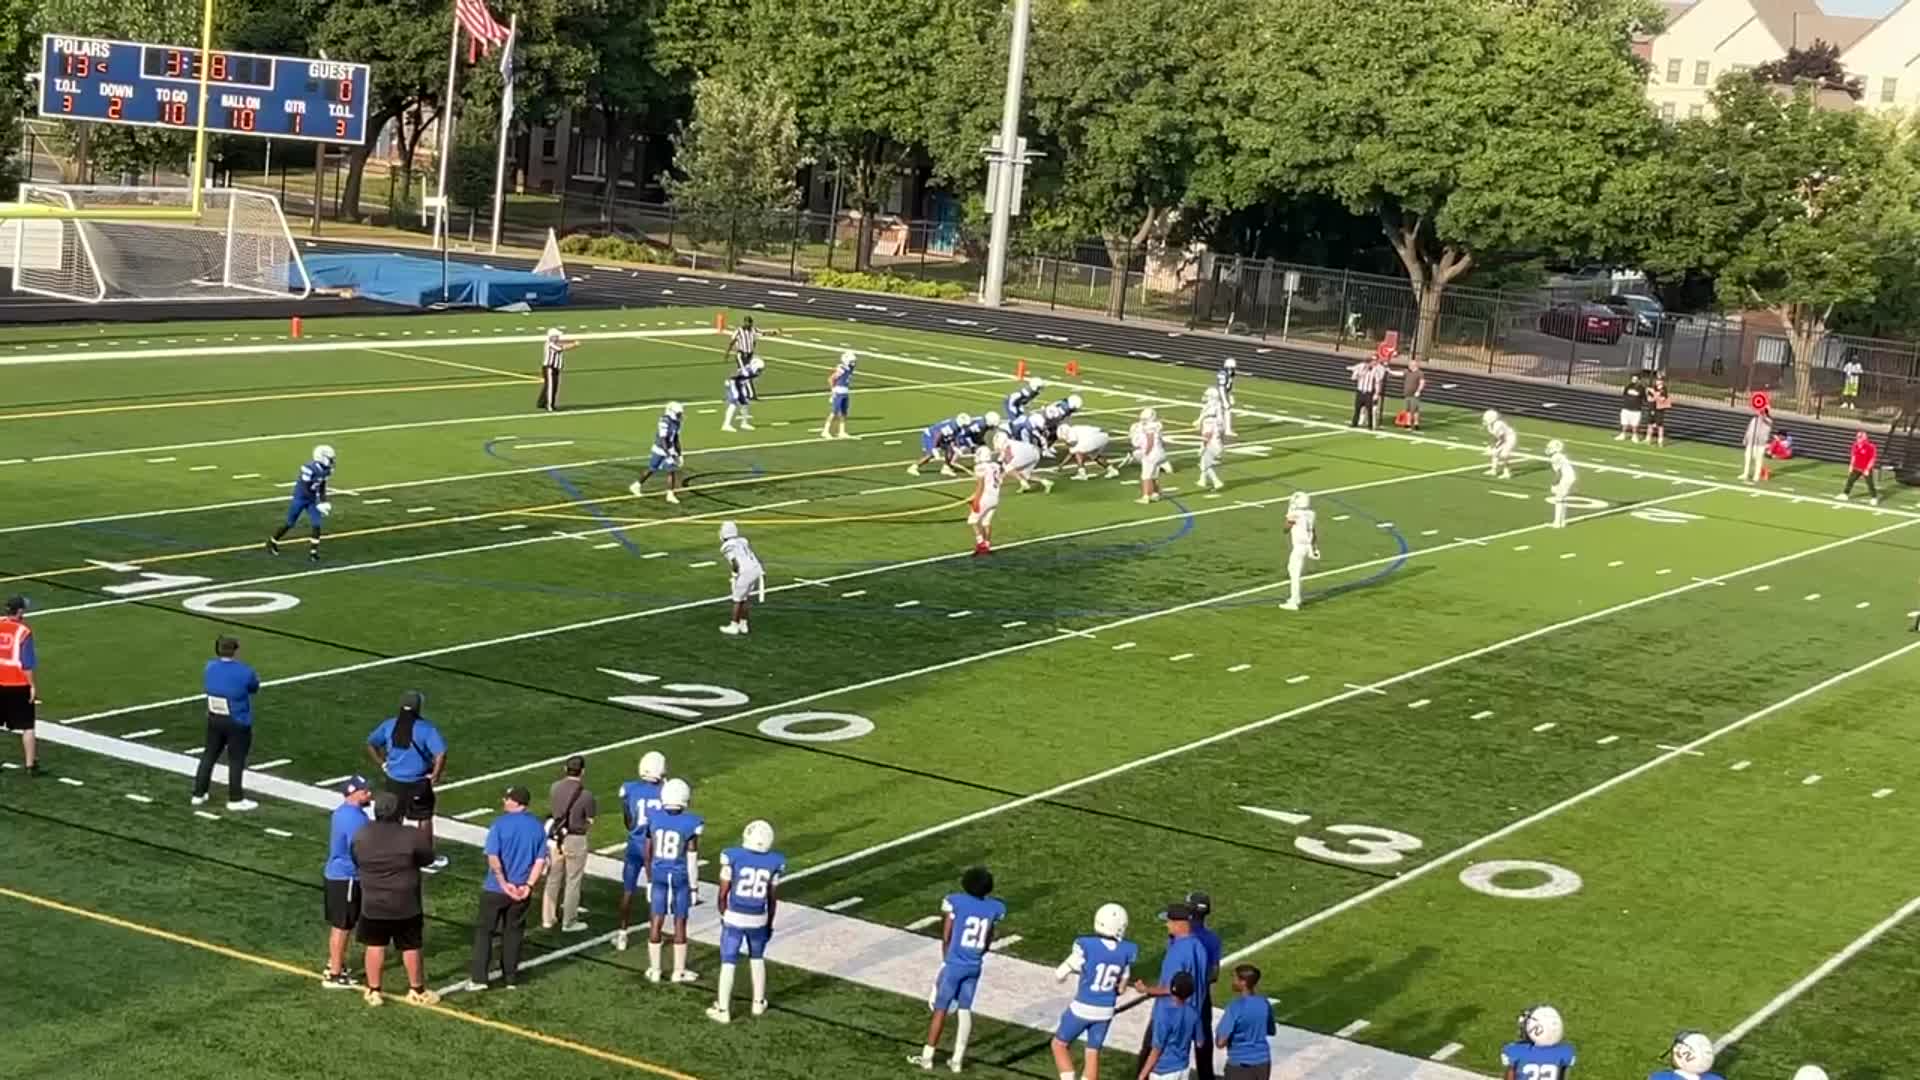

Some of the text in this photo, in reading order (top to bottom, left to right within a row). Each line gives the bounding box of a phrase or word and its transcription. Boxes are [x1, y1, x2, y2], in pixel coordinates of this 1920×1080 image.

[53, 39, 110, 58] POLARS
[66, 56, 89, 77] 13
[309, 63, 356, 80] GUEST
[100, 83, 133, 98] DOWN
[156, 88, 188, 103] TO GO
[340, 80, 352, 101] 0
[63, 95, 72, 112] 3
[108, 97, 122, 119] 2
[221, 94, 261, 110] BALL ON
[284, 100, 306, 113] QTR
[164, 103, 186, 124] 10
[232, 109, 254, 131] 10
[335, 119, 346, 136] 3
[655, 829, 680, 859] 18
[735, 867, 770, 898] 26
[960, 916, 989, 949] 21
[1089, 963, 1121, 992] 16
